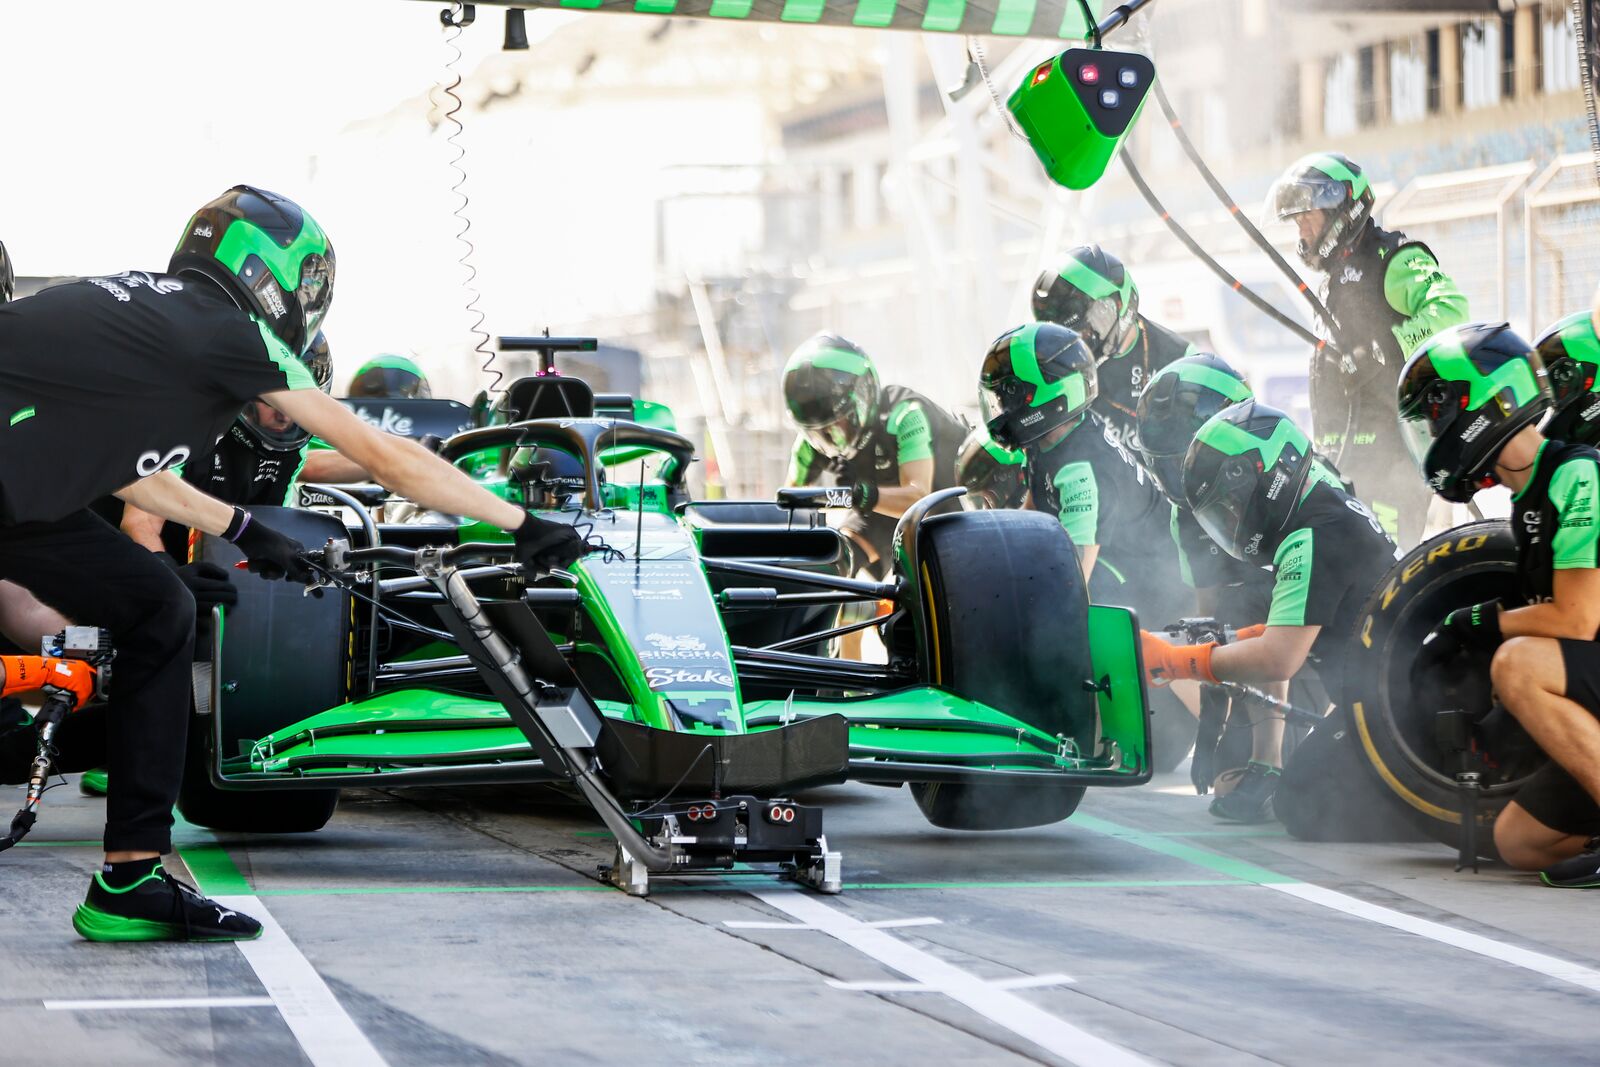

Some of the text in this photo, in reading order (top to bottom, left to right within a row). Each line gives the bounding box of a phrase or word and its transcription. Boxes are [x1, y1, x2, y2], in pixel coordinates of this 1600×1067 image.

[265, 283, 287, 316] MASCOT
[1021, 411, 1041, 424] MASCOT
[1460, 415, 1485, 440] MASCOT
[1266, 472, 1282, 499] MASCOT
[825, 490, 852, 507] Stake
[1244, 533, 1263, 555] Stake
[1361, 534, 1488, 648] P ZERO
[639, 650, 726, 660] SINGHA
[646, 667, 734, 688] Stake
